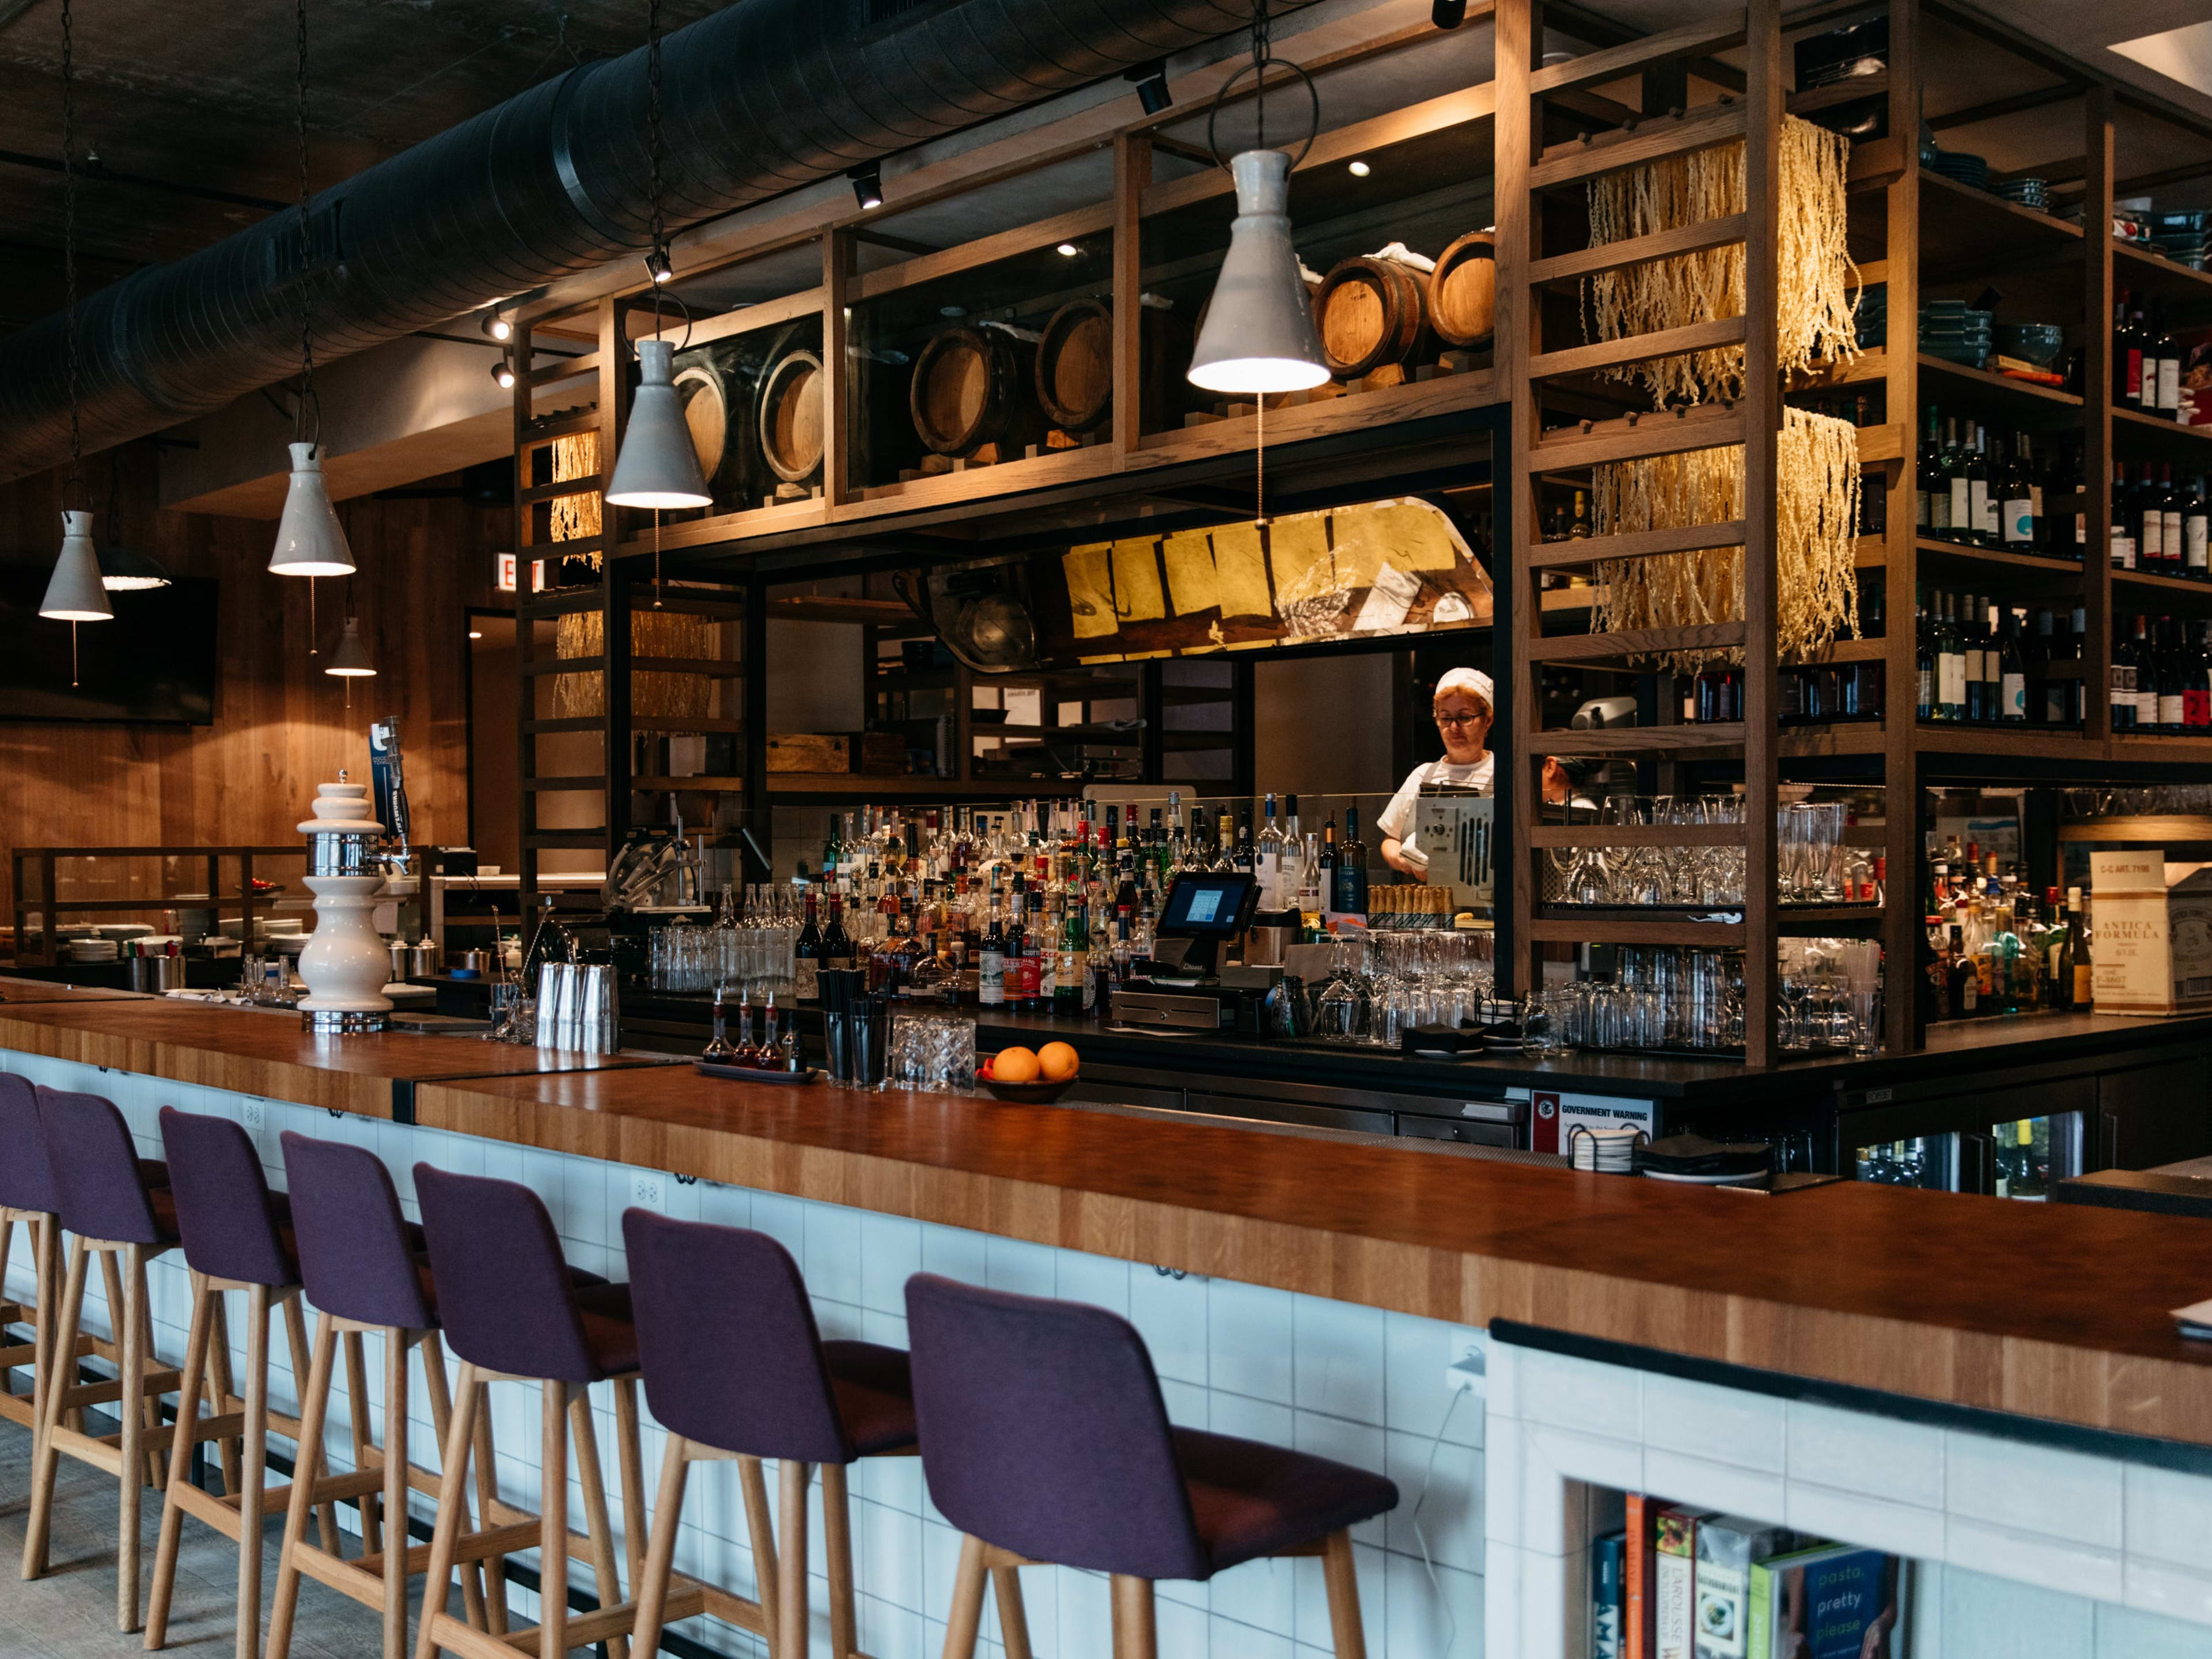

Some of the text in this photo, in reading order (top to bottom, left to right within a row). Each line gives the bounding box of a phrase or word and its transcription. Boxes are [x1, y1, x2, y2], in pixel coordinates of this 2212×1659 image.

[505, 560, 539, 588] ET
[2096, 931, 2159, 939] FORMULA
[2104, 922, 2152, 930] ANTICA
[1562, 1105, 1647, 1121] GOVERNMENT WARNING
[1672, 1567, 1683, 1642] LAROUSSE
[1817, 1591, 1861, 1618] pretty
[1815, 1620, 1861, 1645] please
